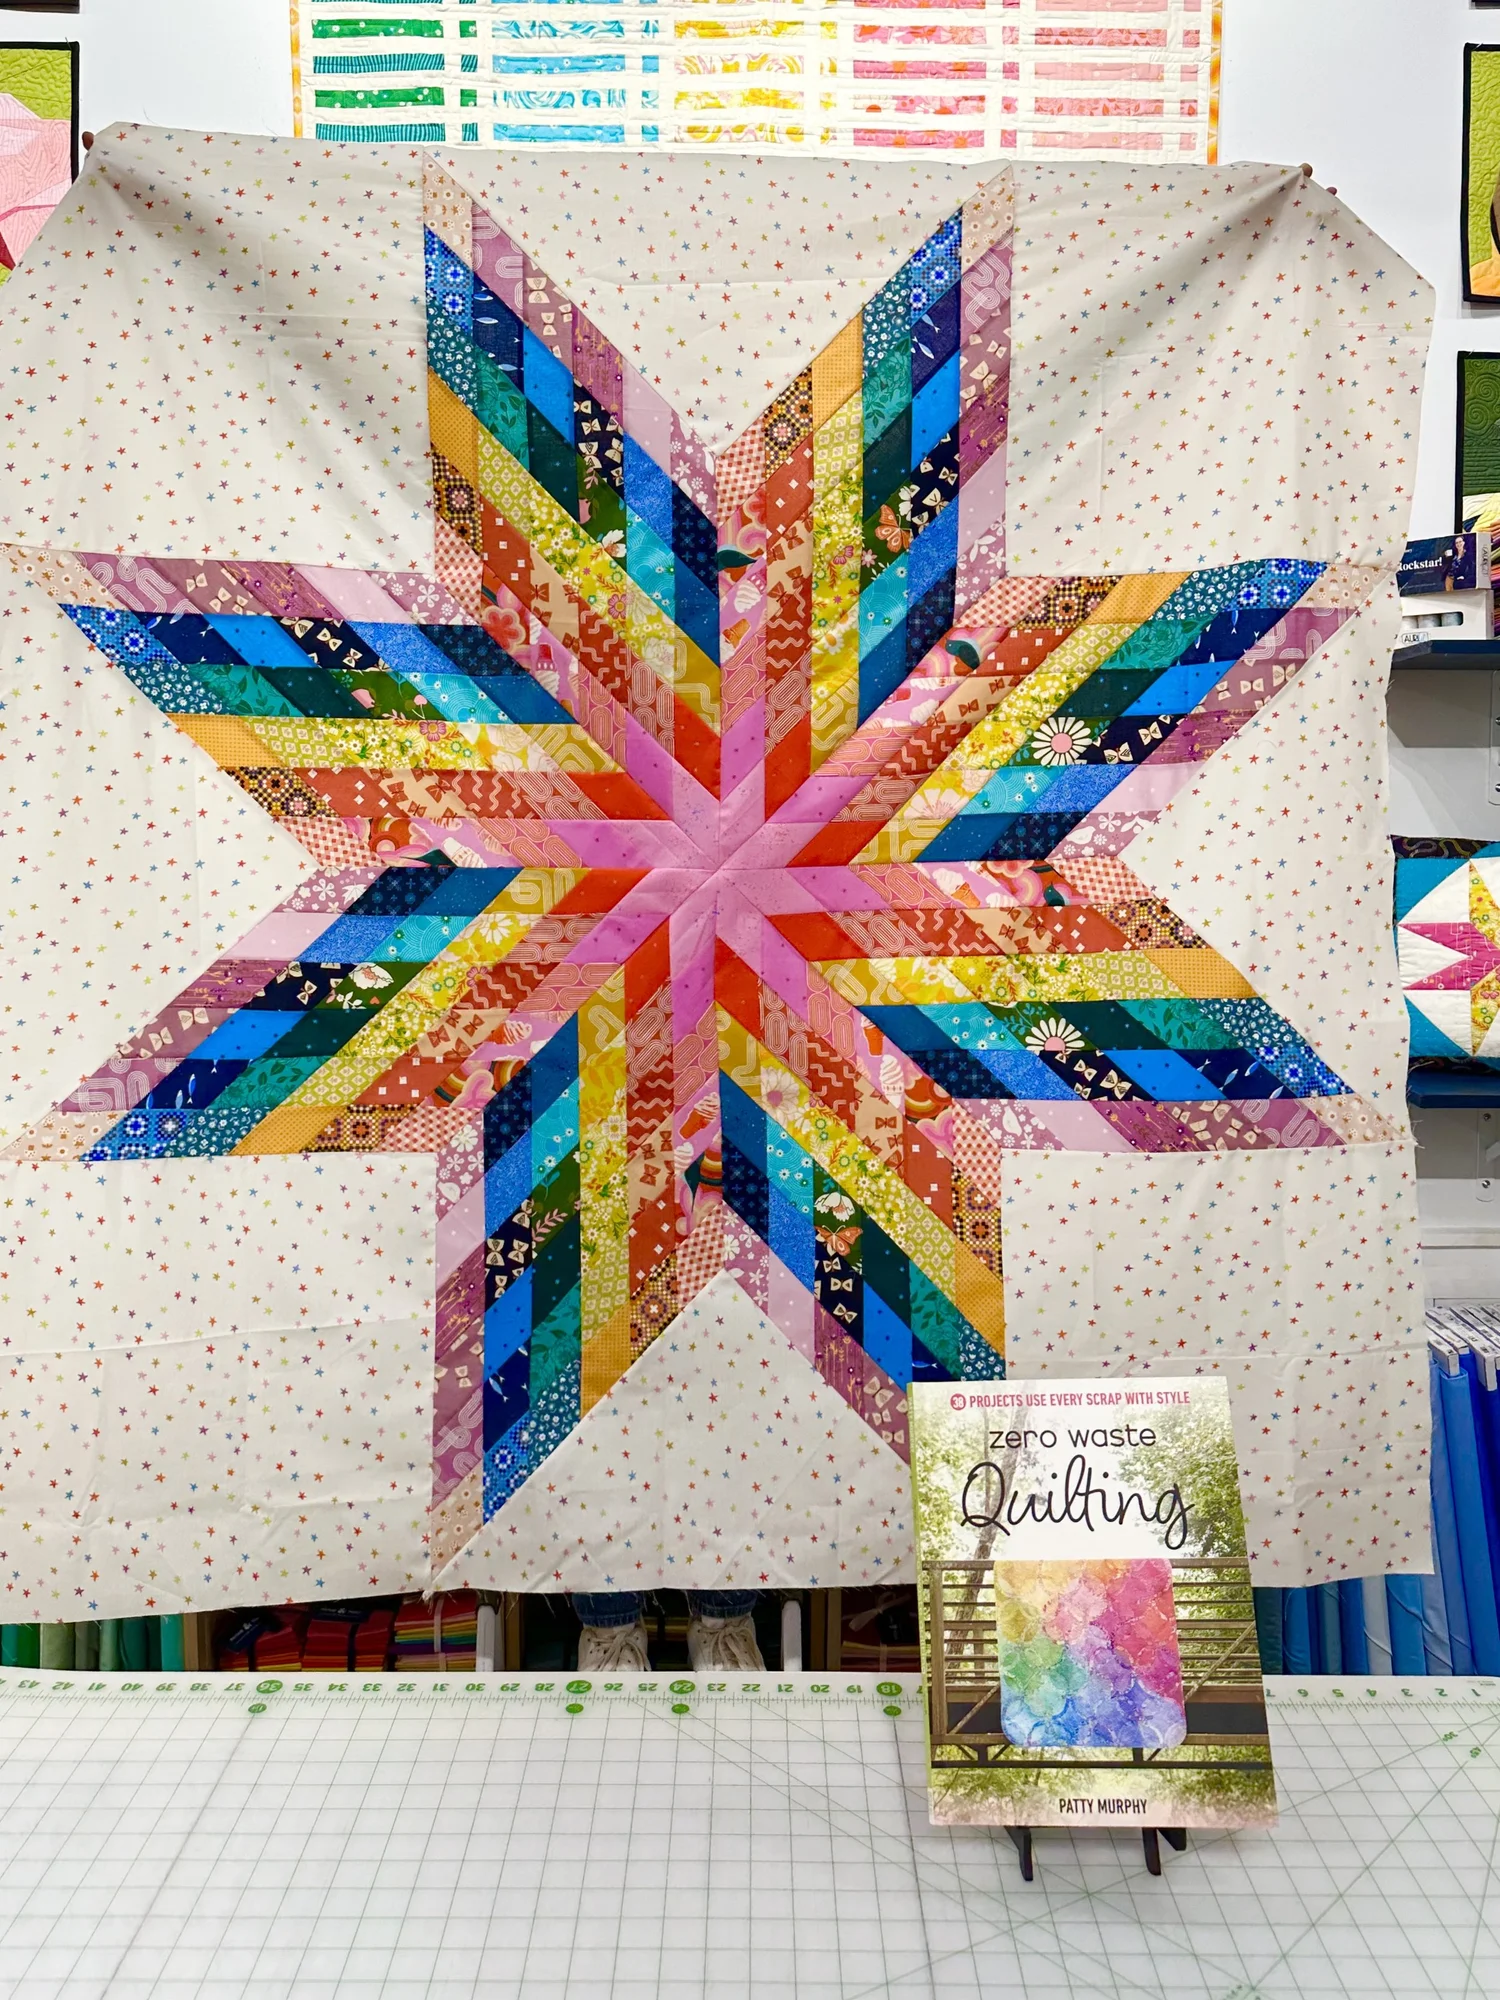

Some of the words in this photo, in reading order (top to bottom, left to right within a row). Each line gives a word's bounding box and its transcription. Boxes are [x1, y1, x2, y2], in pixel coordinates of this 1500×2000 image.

[952, 1396, 964, 1408] 38
[969, 1394, 1023, 1408] PROJECTS
[1026, 1394, 1047, 1407] USE
[1050, 1393, 1083, 1406] EVERY
[1086, 1392, 1122, 1406] SCRAP
[1125, 1392, 1152, 1405] WITH
[1156, 1391, 1190, 1404] STYLE
[989, 1429, 1057, 1449] zero
[1068, 1424, 1157, 1448] waste
[960, 1454, 1195, 1550] Quilting
[18, 1680, 39, 1690] 43
[52, 1681, 74, 1691] 42
[88, 1682, 106, 1692] 41
[120, 1682, 142, 1692] 40
[156, 1682, 176, 1692] 39
[190, 1682, 211, 1692] 38
[224, 1682, 244, 1692] 37
[259, 1682, 281, 1692] 36
[293, 1682, 313, 1692] 35
[327, 1682, 348, 1692] 34
[362, 1682, 382, 1692] 33
[397, 1682, 416, 1692] 32
[432, 1683, 448, 1692] 31
[464, 1682, 485, 1692] 30
[500, 1682, 520, 1692] 29
[535, 1682, 555, 1692] 28
[569, 1682, 588, 1692] 27
[603, 1682, 623, 1692] 26
[638, 1683, 659, 1692] 25
[673, 1682, 692, 1692] 24
[707, 1683, 727, 1693] 23
[741, 1683, 761, 1693] 22
[777, 1683, 794, 1693] 21
[809, 1684, 831, 1694] 20
[846, 1685, 863, 1694] 19
[881, 1684, 897, 1693] 18
[1297, 1688, 1309, 1698] 6
[1332, 1688, 1344, 1698] 5
[1366, 1688, 1377, 1698] 4
[1401, 1688, 1413, 1697] 3
[1435, 1688, 1448, 1697] 2
[1471, 1688, 1481, 1697] 1
[1059, 1799, 1093, 1814] PATTY
[1098, 1798, 1147, 1814] MURPHY
